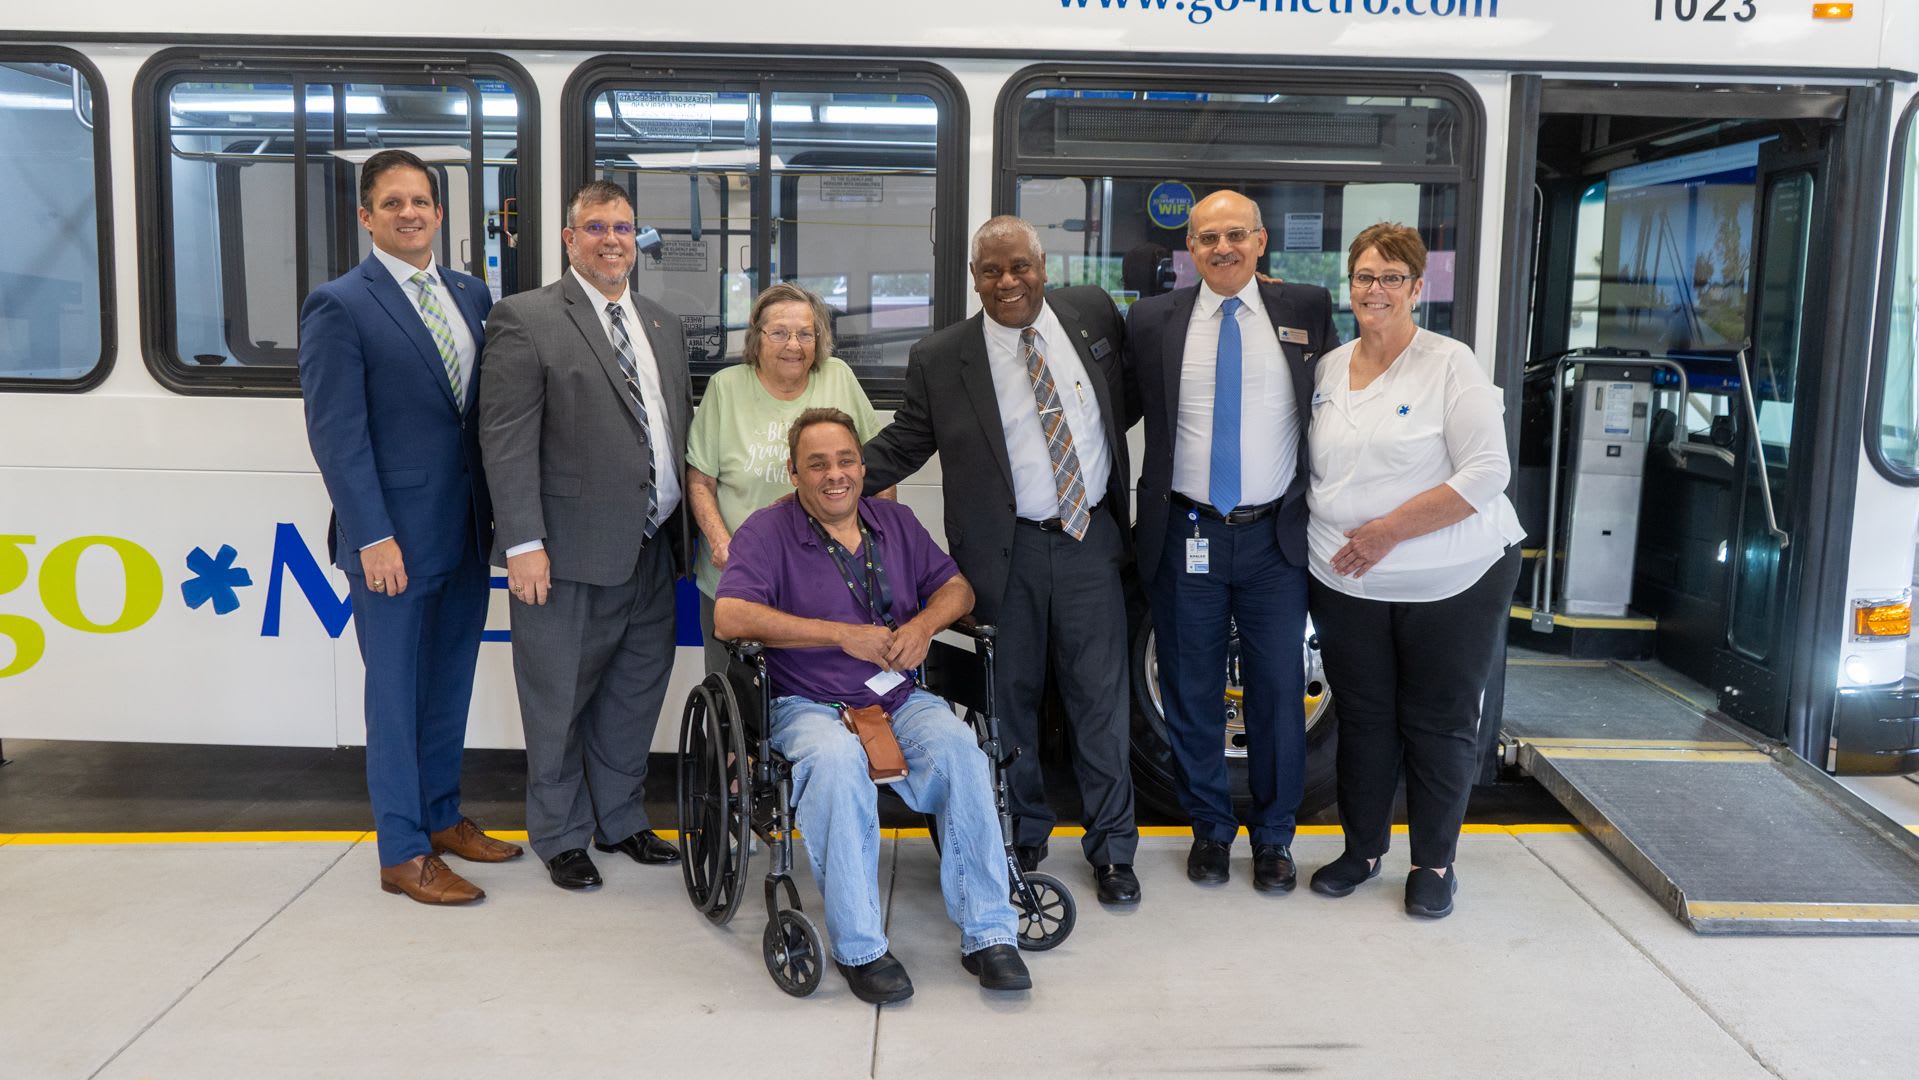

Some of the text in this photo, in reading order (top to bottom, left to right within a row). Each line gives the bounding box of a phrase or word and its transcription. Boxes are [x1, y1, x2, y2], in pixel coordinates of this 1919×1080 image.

[1654, 0, 1757, 22] 1023
[766, 461, 791, 485] EVE
[1007, 855, 1020, 881] Cruiser
